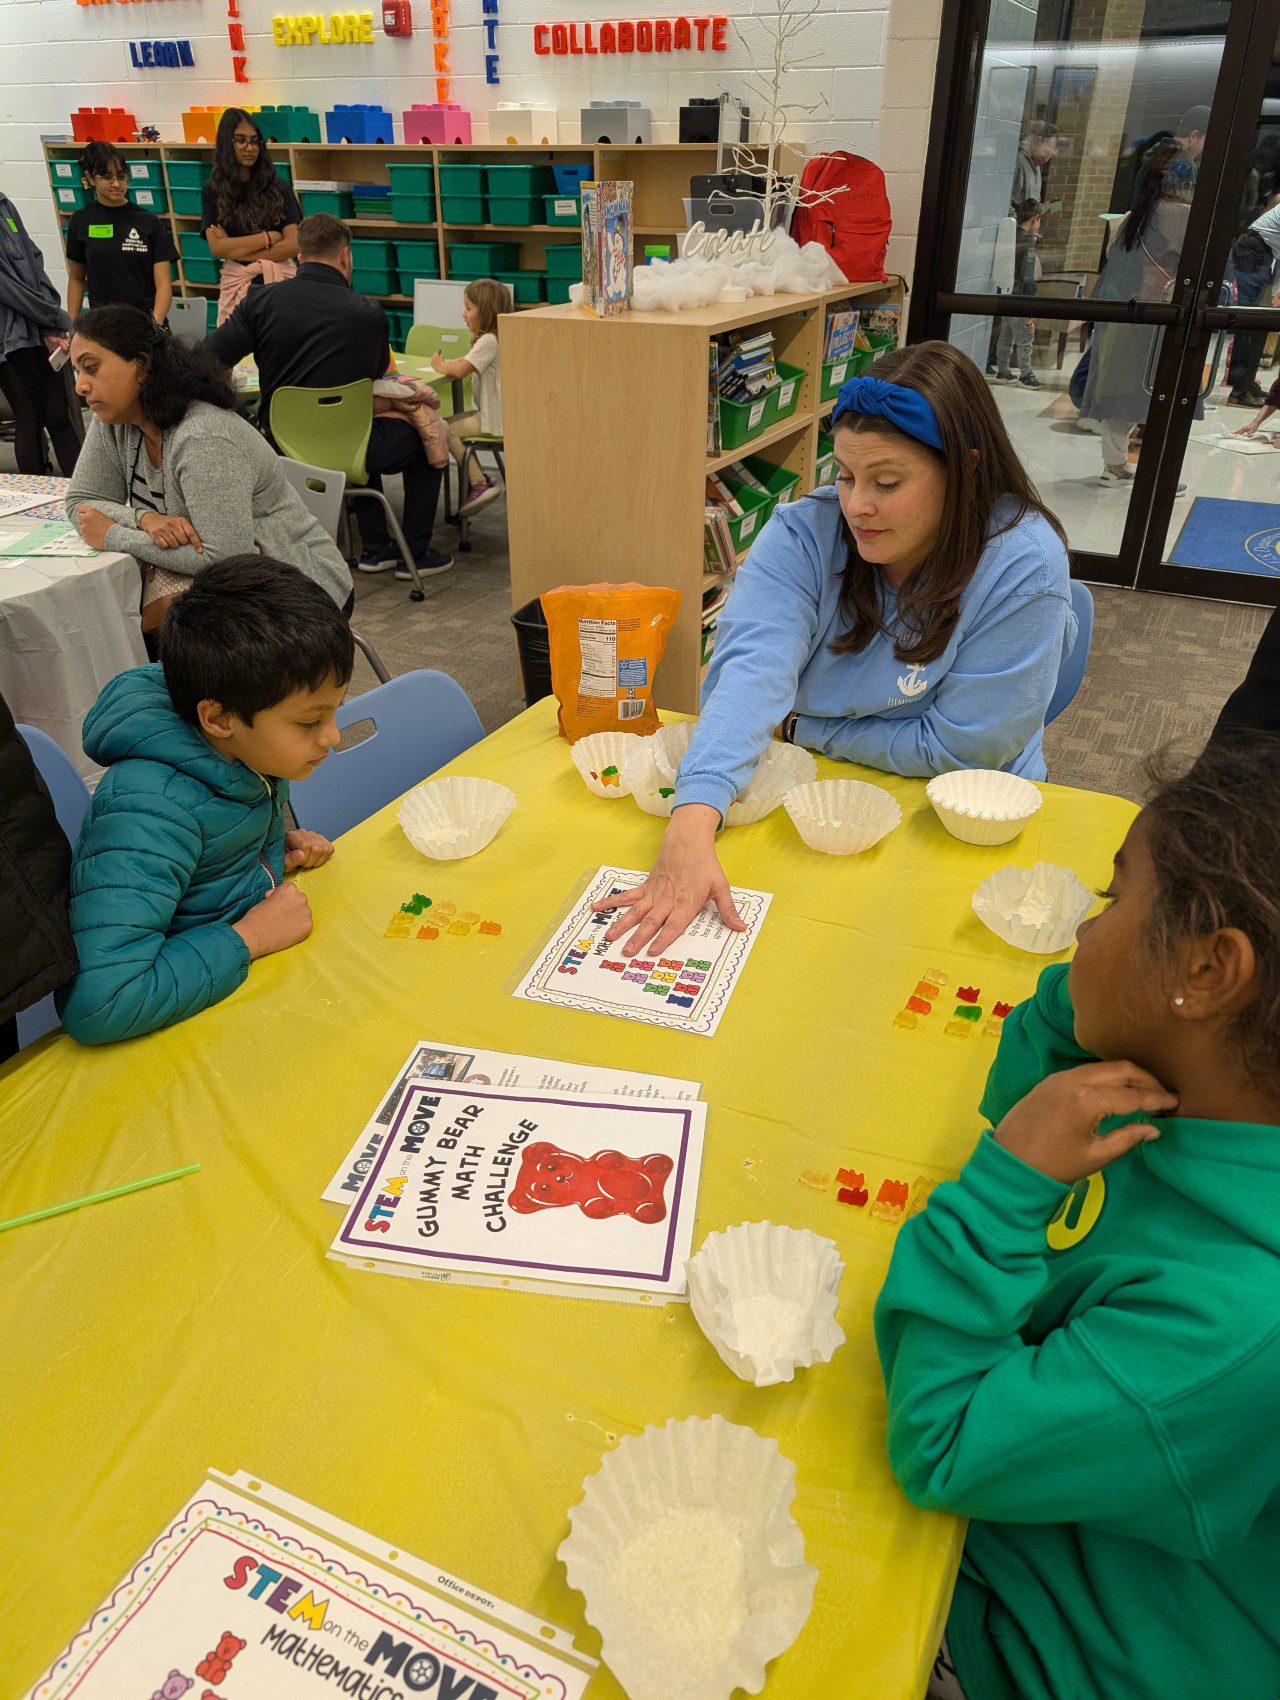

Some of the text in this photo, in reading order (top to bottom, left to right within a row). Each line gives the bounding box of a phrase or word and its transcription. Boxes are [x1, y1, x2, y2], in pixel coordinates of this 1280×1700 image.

[272, 13, 374, 45] EXPLORE
[534, 16, 728, 55] COLLABORATE
[129, 40, 195, 68] LEARN
[682, 219, 775, 262] Create
[558, 939, 594, 975] STEM
[399, 1095, 442, 1154] MOVE
[341, 1133, 384, 1192] MOVE
[402, 1154, 413, 1167] the
[416, 1155, 447, 1238] GUMMY
[436, 1104, 485, 1150] BEAR
[451, 1145, 485, 1200] MATH
[482, 1118, 539, 1233] CHALLENGE
[364, 1176, 408, 1233] STEM
[224, 1556, 330, 1631] STEM
[323, 1619, 342, 1638] on
[344, 1628, 370, 1652] the
[437, 1575, 465, 1594] Office
